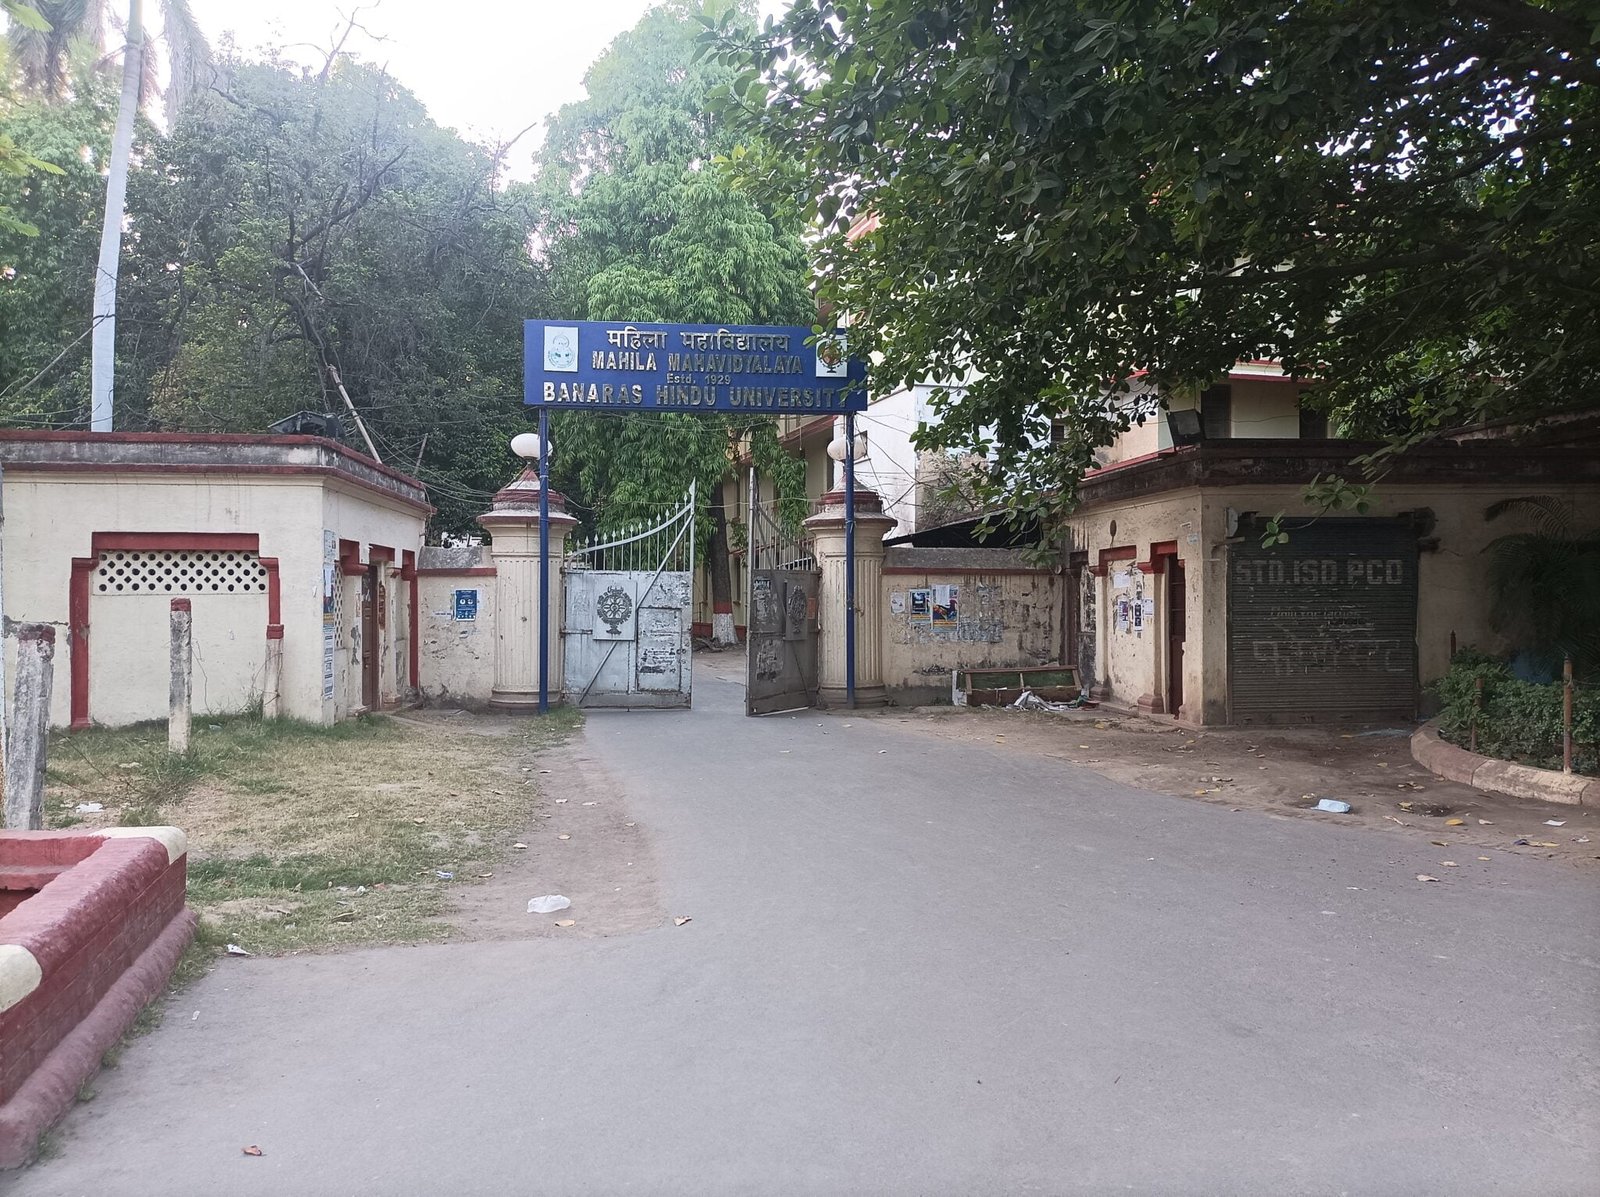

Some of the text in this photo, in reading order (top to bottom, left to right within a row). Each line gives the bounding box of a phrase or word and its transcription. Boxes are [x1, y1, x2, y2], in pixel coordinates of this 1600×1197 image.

[606, 325, 791, 352] महिला महाविद्यालय
[592, 350, 804, 374] MAHILA MAHAVIDYALAYA
[666, 373, 732, 385] Estd. 1929
[543, 381, 643, 404] BANARAS
[656, 384, 717, 406] HINDU
